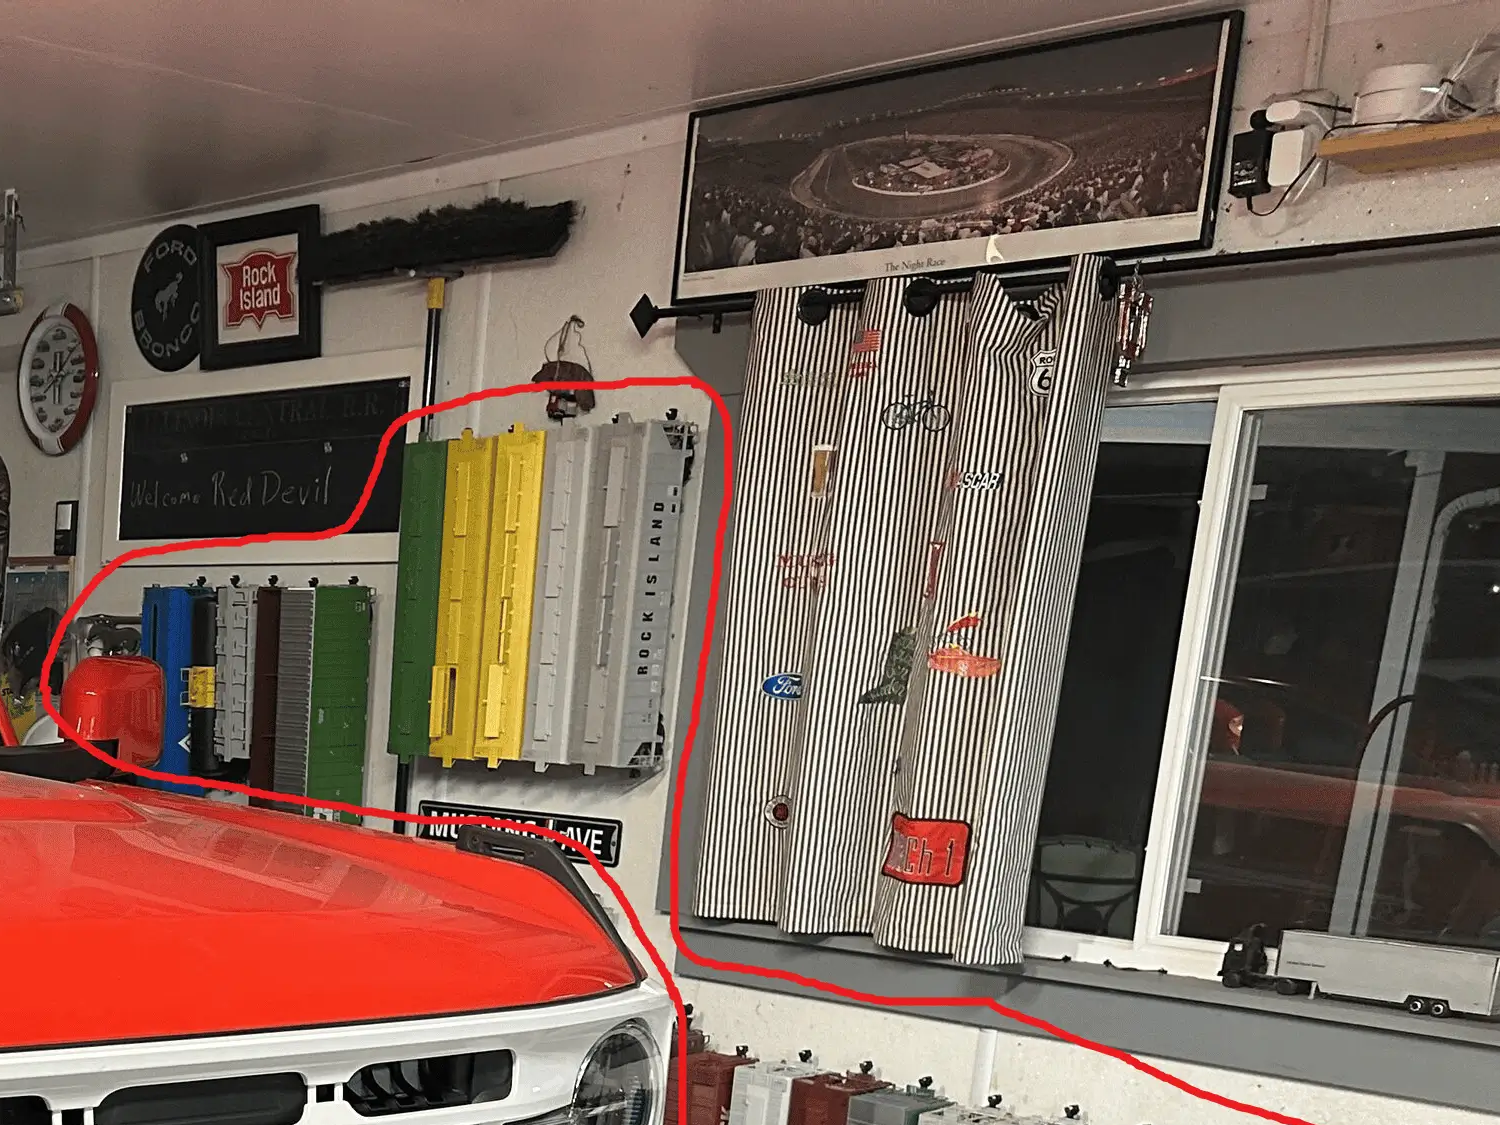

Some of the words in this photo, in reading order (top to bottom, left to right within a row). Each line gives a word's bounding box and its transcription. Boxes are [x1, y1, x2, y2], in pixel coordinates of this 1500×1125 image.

[143, 239, 198, 273] FORD
[885, 263, 899, 273] The
[901, 259, 924, 271] Night
[926, 257, 945, 268] Race
[242, 261, 277, 288] Rock
[239, 284, 281, 311] Island
[130, 480, 201, 508] Welcome
[211, 470, 253, 507] Red
[260, 465, 332, 506] Devil
[644, 501, 666, 597] ISLAND
[637, 611, 655, 676] ROCK
[561, 826, 604, 855] AVE
